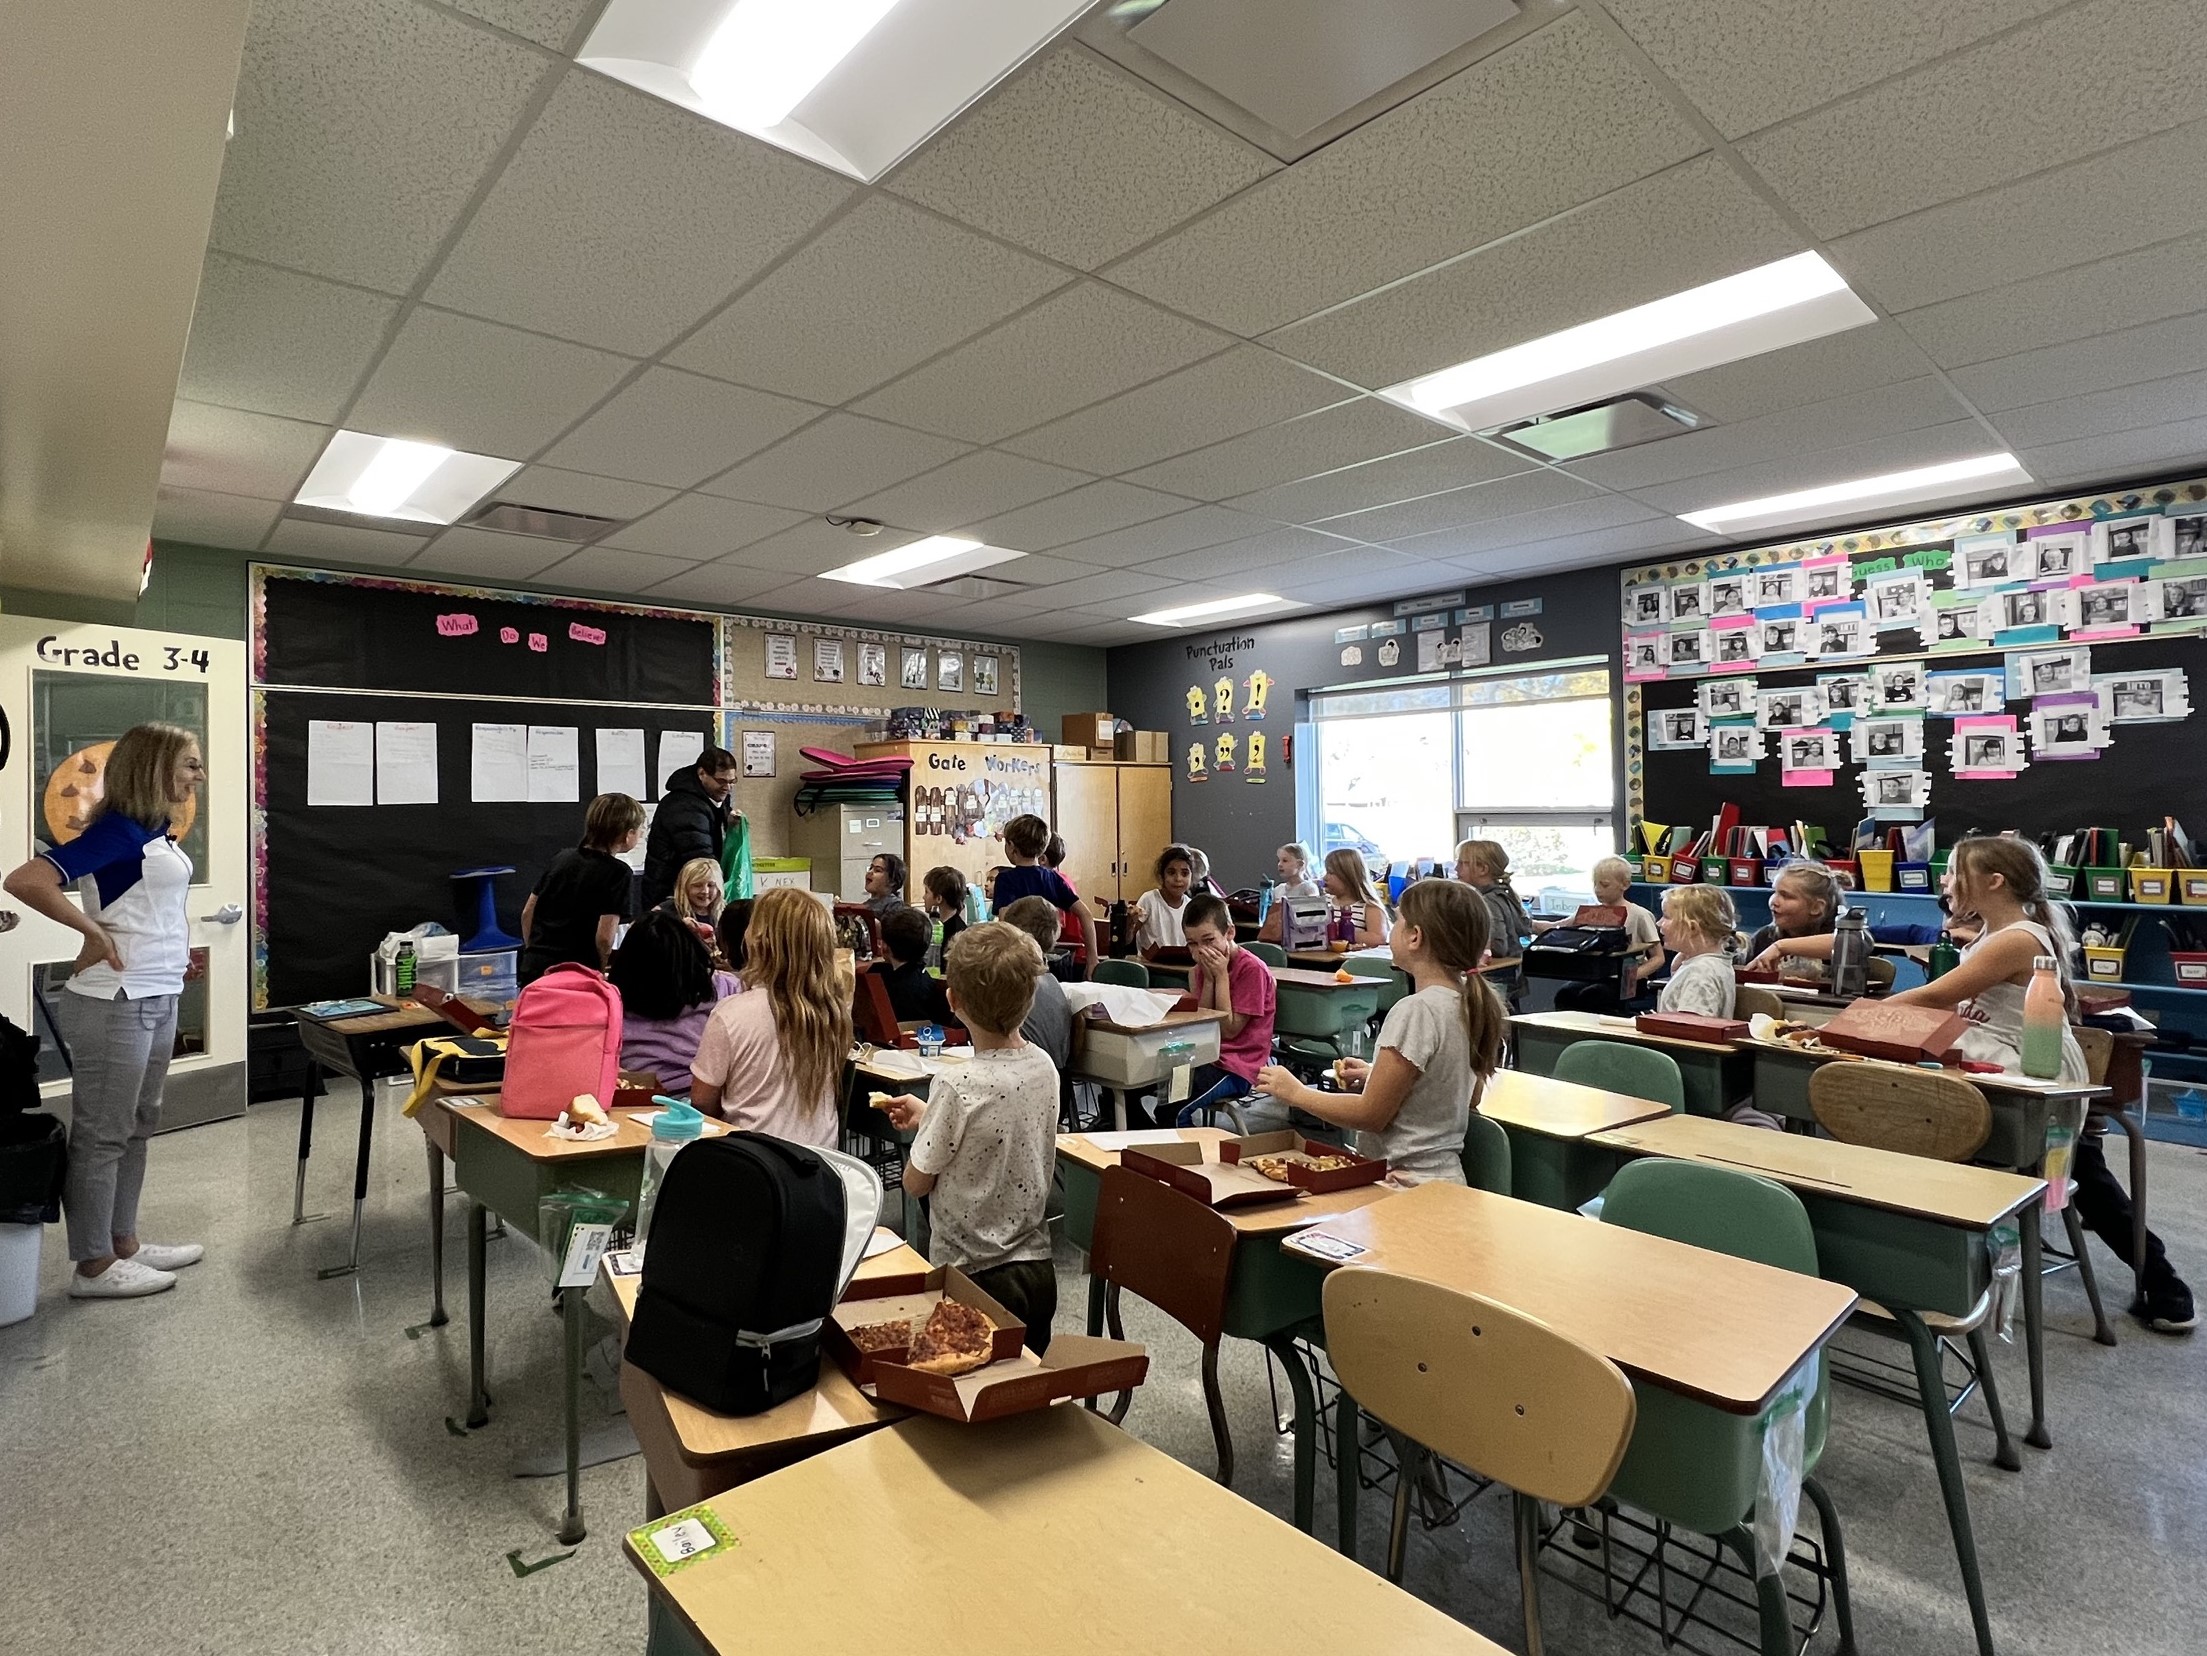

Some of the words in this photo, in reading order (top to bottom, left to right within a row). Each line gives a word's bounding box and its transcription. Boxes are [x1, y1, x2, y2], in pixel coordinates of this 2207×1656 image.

[1911, 554, 1945, 567] Who
[441, 619, 474, 632] What
[502, 630, 516, 640] Do
[532, 637, 546, 650] We
[36, 635, 140, 671] Grade
[163, 646, 210, 674] 3-4
[1186, 636, 1255, 660] Punctuation
[1209, 654, 1234, 671] Pals
[928, 753, 966, 771] Gate
[1550, 898, 1577, 911] Inbo
[397, 958, 413, 990] PRIME
